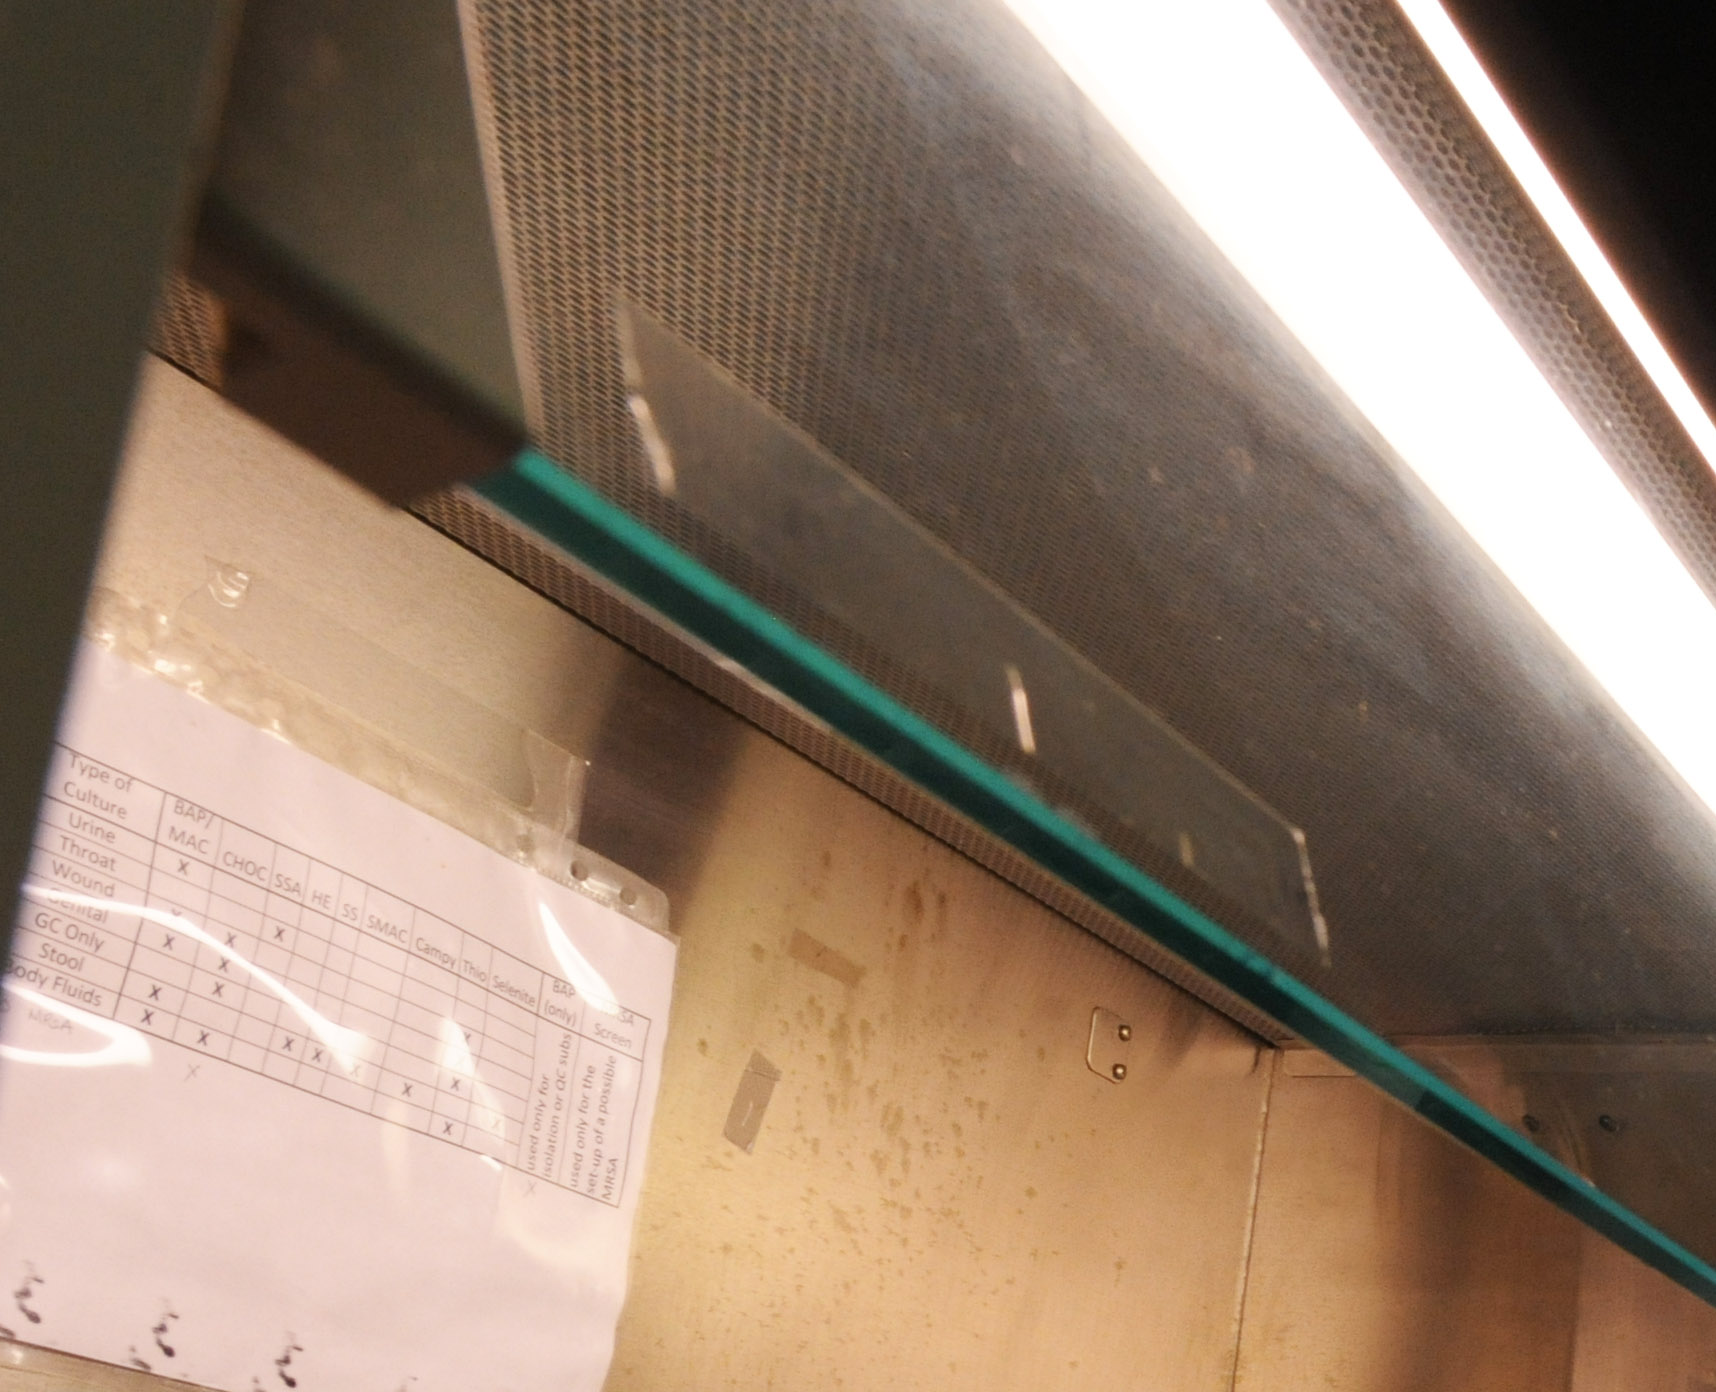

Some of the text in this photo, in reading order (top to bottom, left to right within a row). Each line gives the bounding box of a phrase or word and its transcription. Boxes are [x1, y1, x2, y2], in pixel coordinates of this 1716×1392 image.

[69, 753, 134, 793] Type of
[64, 781, 128, 820] Culture
[174, 799, 214, 830] BAP/
[68, 812, 116, 844] Urine
[168, 825, 209, 855] MAC
[60, 835, 117, 872] Throat
[222, 851, 268, 882] CHOC
[52, 860, 115, 898] Wound
[275, 873, 301, 897] SSA
[312, 890, 332, 910] HE
[342, 903, 359, 921] SS
[35, 911, 105, 953] GC Only
[367, 914, 408, 944] SMAC
[38, 942, 85, 972] Stool
[416, 937, 456, 970] Campy
[462, 960, 487, 982] Thio
[53, 976, 103, 1007] Fluids
[492, 975, 536, 1008] Selenite
[552, 980, 576, 999] BAP
[544, 1000, 577, 1028] (only)
[594, 1023, 632, 1049] Screen
[598, 1055, 617, 1116] possible
[543, 1033, 572, 1179] isolation or QC subs
[527, 1075, 550, 1171] used only for
[571, 1065, 596, 1188] used only for the
[593, 1125, 604, 1145] of
[587, 1148, 603, 1194] set-up
[601, 1157, 618, 1201] MRSA
